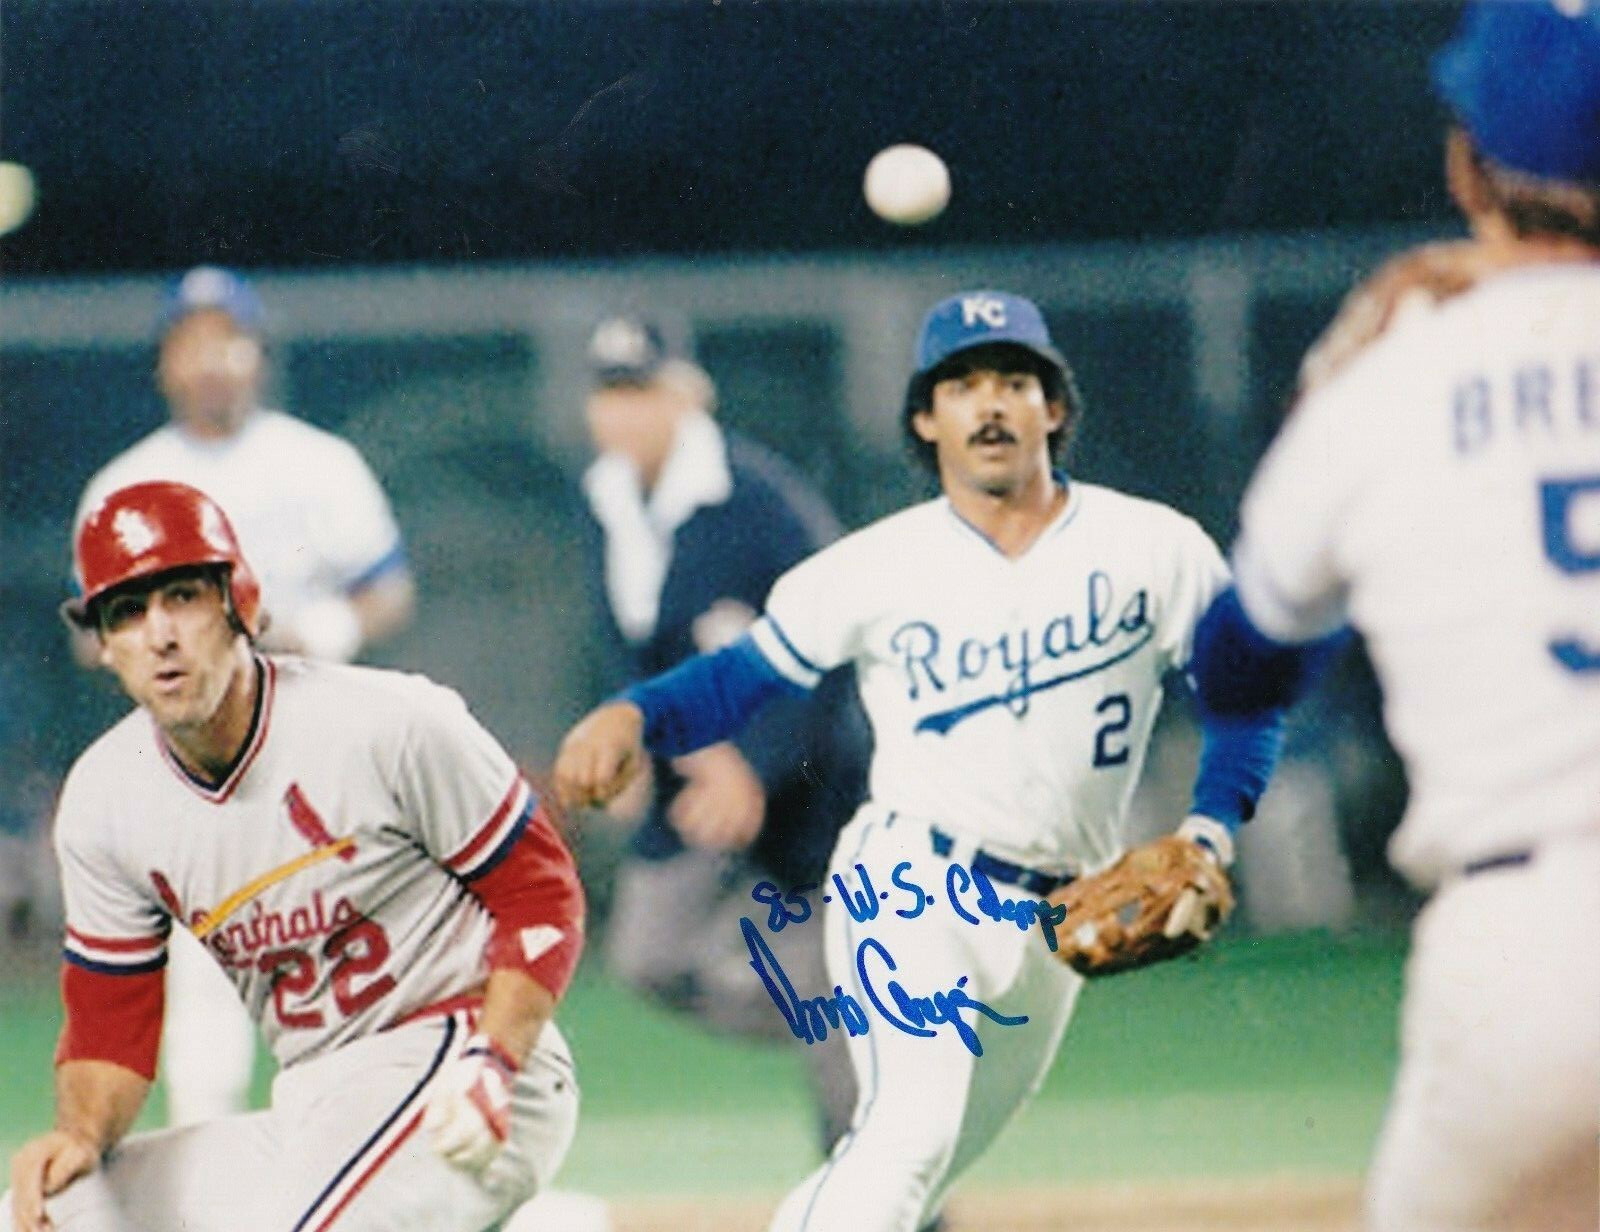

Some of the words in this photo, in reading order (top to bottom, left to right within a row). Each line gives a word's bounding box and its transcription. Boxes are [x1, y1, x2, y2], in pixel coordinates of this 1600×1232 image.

[961, 298, 1007, 328] KC
[890, 570, 1148, 722] Royals
[1093, 693, 1132, 769] 2
[257, 917, 397, 1029] 22
